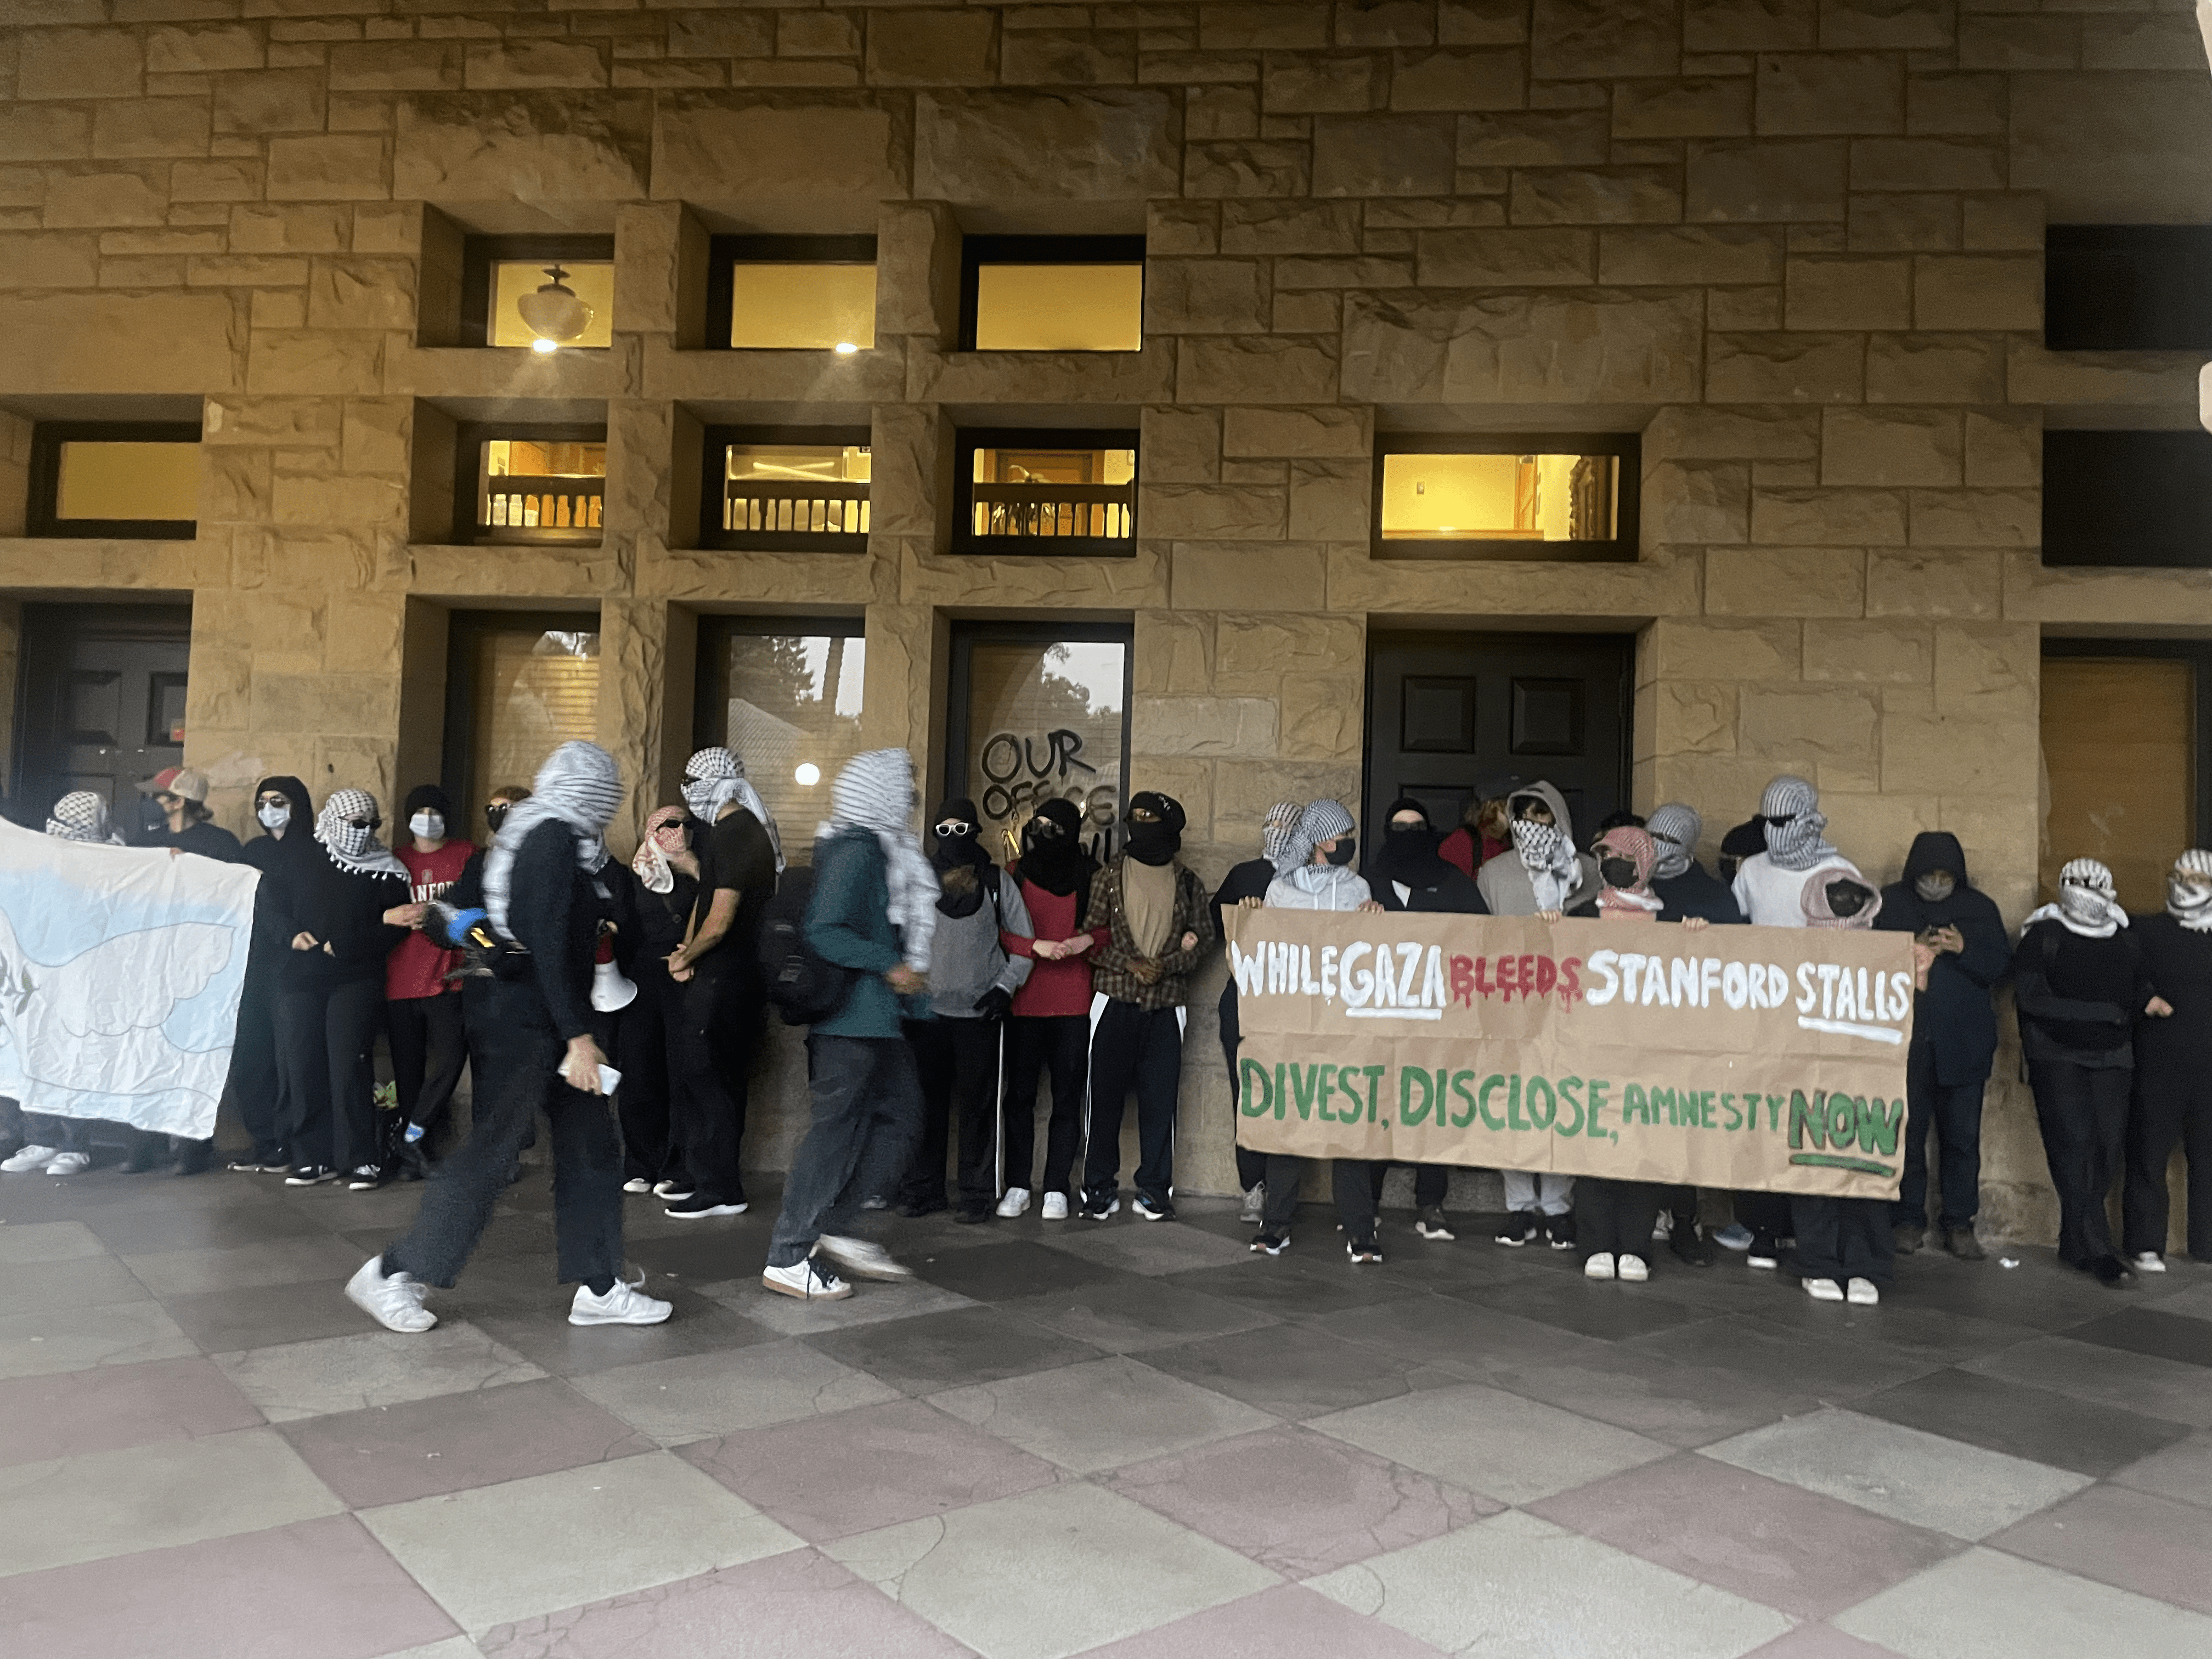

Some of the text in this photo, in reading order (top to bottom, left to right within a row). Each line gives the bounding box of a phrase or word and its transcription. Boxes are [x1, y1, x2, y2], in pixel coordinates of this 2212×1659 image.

[981, 729, 1096, 783] OUR
[1231, 940, 1911, 1022] WHILE GAZA BLEEDS STANFORD STALLS
[1239, 1058, 1904, 1156] DIVEST, DISCLOSE, AMNESTY NOW
